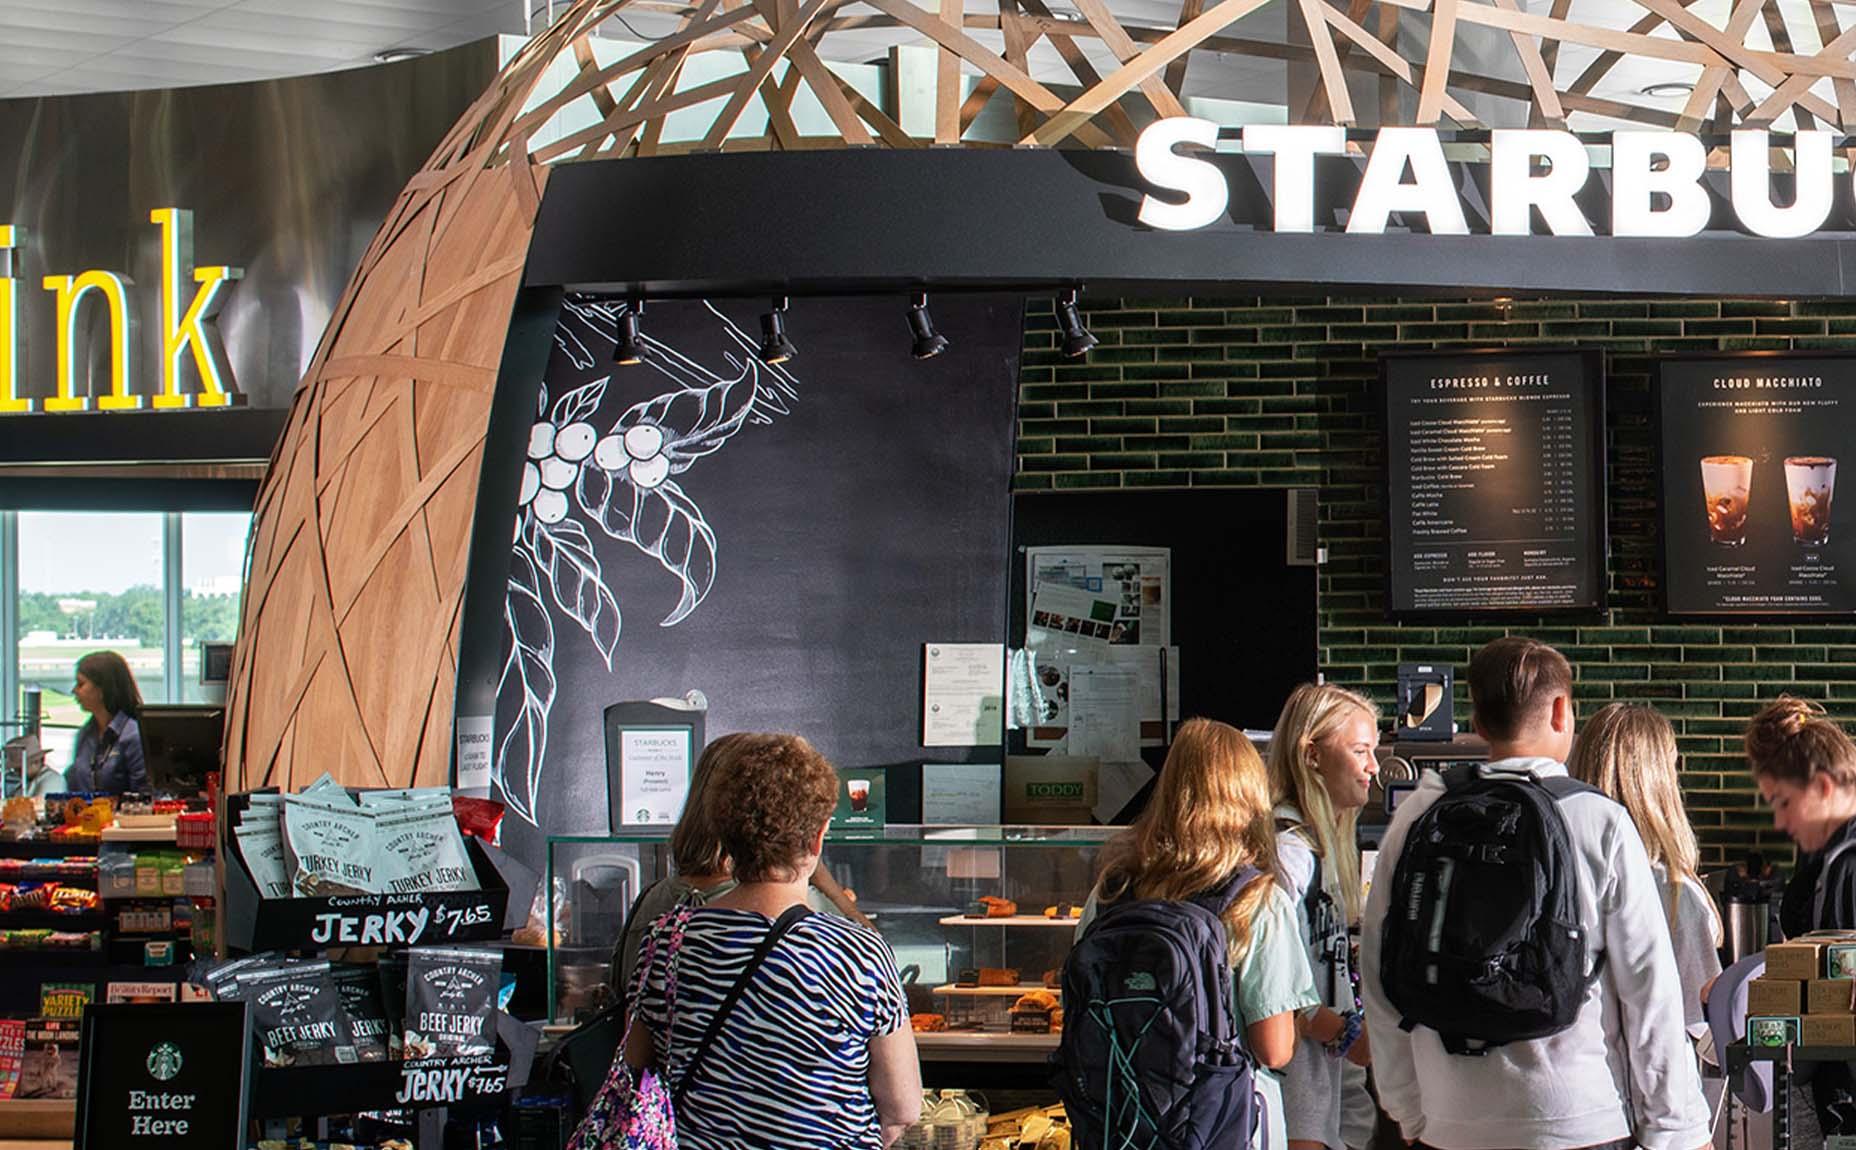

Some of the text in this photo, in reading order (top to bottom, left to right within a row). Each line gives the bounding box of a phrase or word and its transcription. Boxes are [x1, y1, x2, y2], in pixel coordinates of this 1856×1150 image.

[1430, 375, 1550, 389] ESPRESSO & COFFEE
[1713, 377, 1822, 389] CLOUD MACCHIATO
[634, 738, 678, 746] STARBUCKS
[1029, 783, 1085, 796] TODDY
[300, 854, 372, 884] TURKEY JERKY
[390, 867, 468, 893] TURKEY JERKY
[312, 904, 492, 945] JERKY $7.65
[424, 966, 485, 985] COUNTRY ARCHER
[258, 984, 321, 1006] COUNTRY ARCHER
[351, 1019, 386, 1037] JERKY
[420, 1012, 485, 1037] BEEF JERKY
[266, 1021, 337, 1049] BEEF JERKY
[404, 1054, 493, 1069] COUNTRY ARCHER
[468, 1076, 506, 1094] $7.65
[128, 1090, 196, 1110] Enter
[130, 1115, 189, 1136] Here
